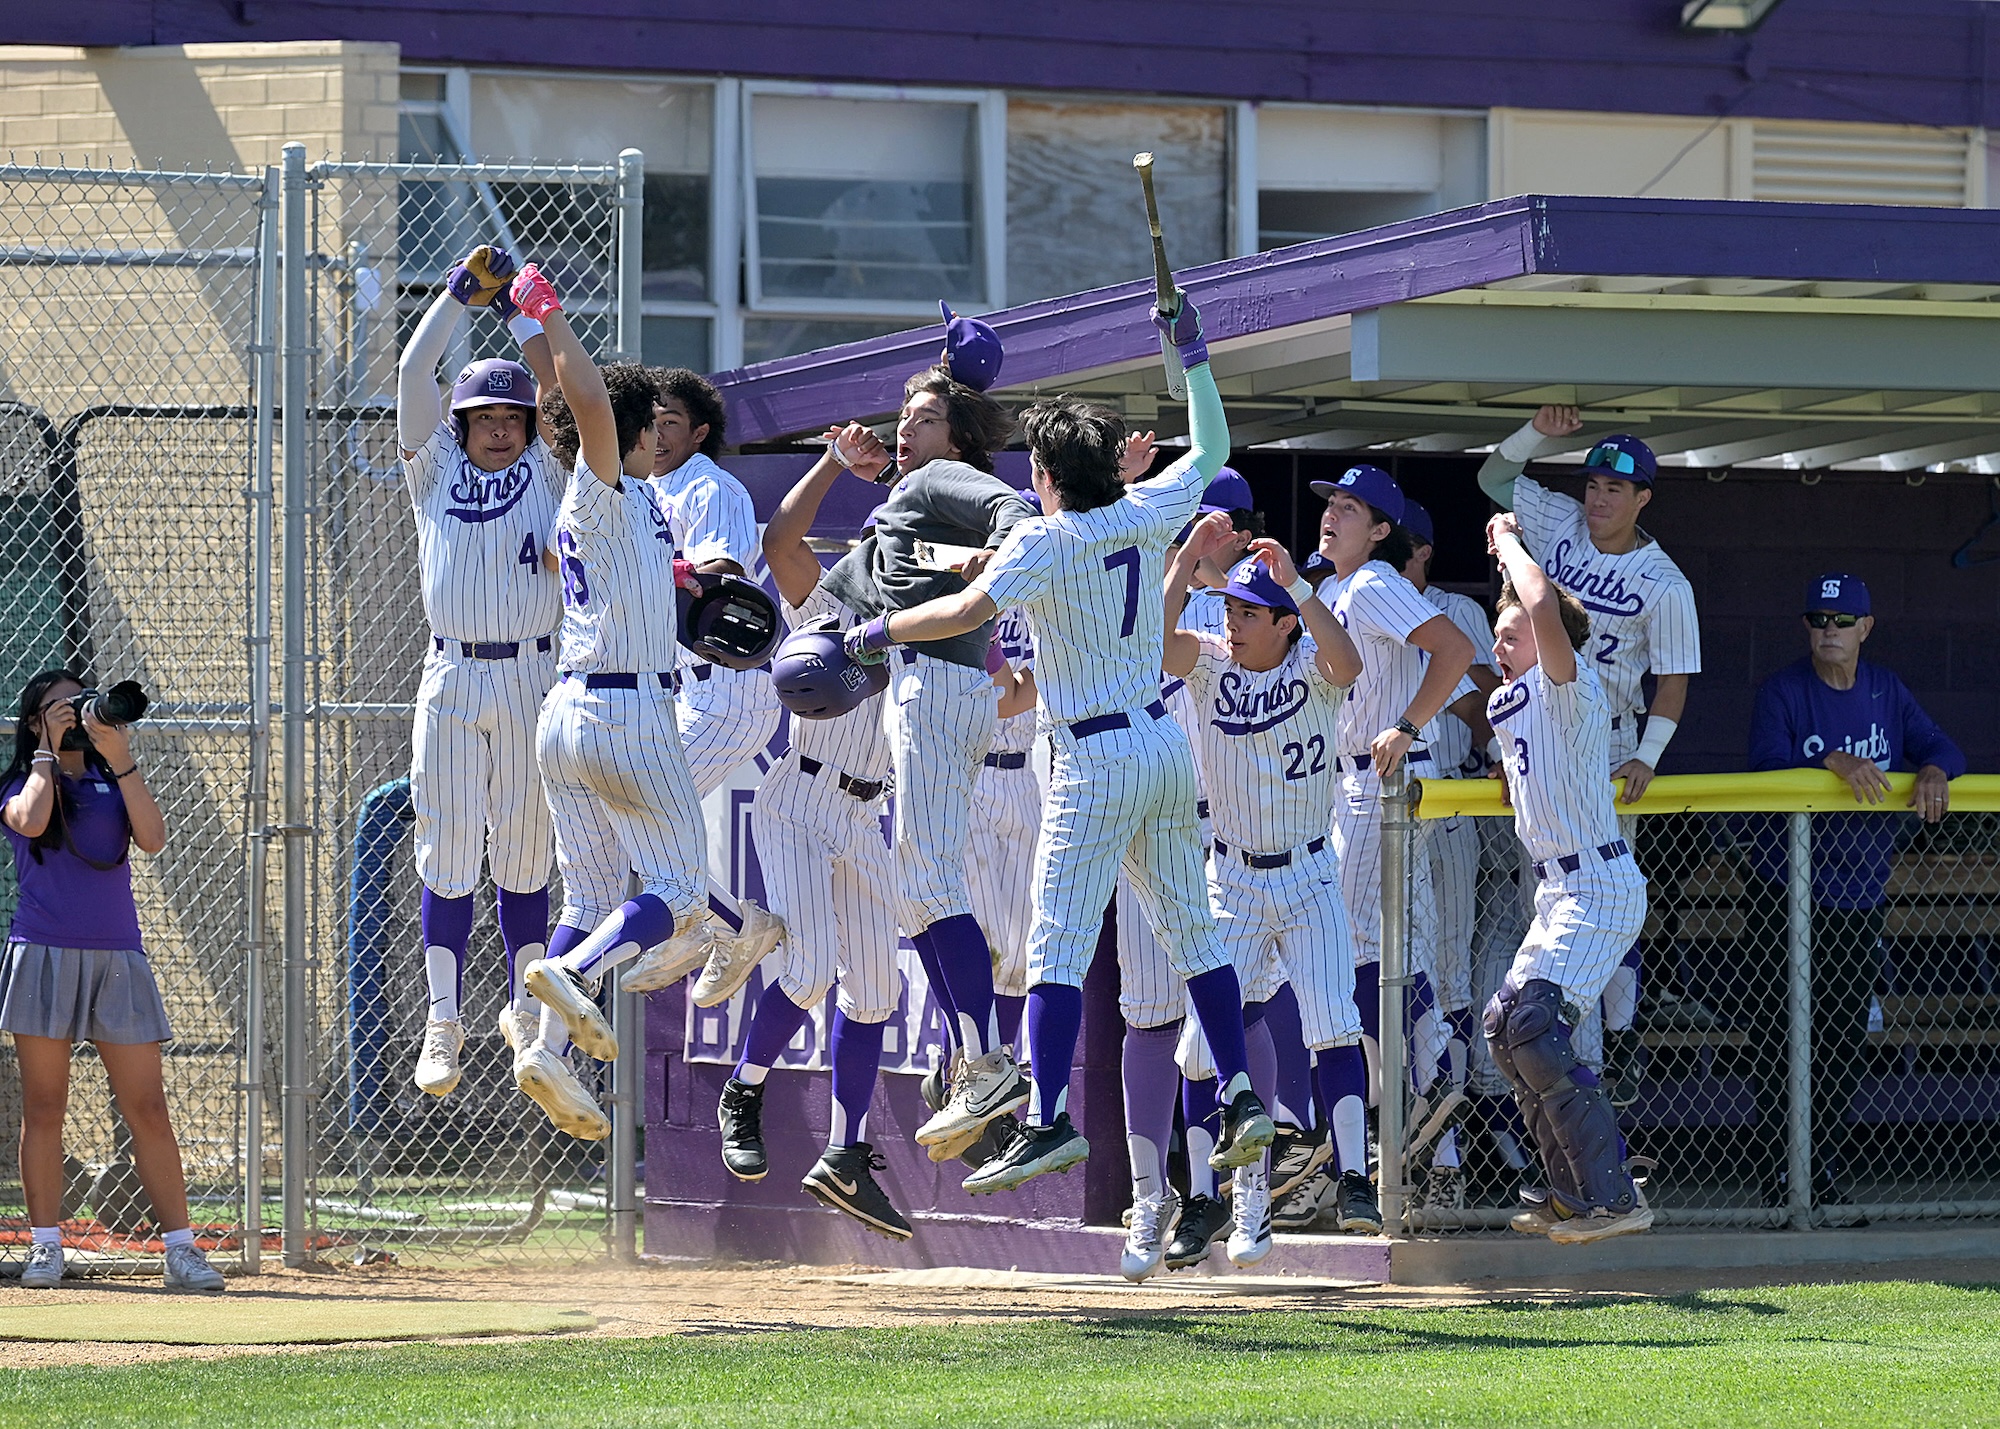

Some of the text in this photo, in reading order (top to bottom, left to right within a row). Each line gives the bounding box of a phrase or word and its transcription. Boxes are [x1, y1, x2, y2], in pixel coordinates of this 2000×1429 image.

[518, 531, 539, 574] 4
[1103, 545, 1141, 639] 7
[1546, 539, 1643, 617] Saints
[1596, 633, 1619, 665] 2
[1282, 734, 1327, 781] 22
[1515, 738, 1529, 776] 3
[1803, 723, 1891, 772] Sints
